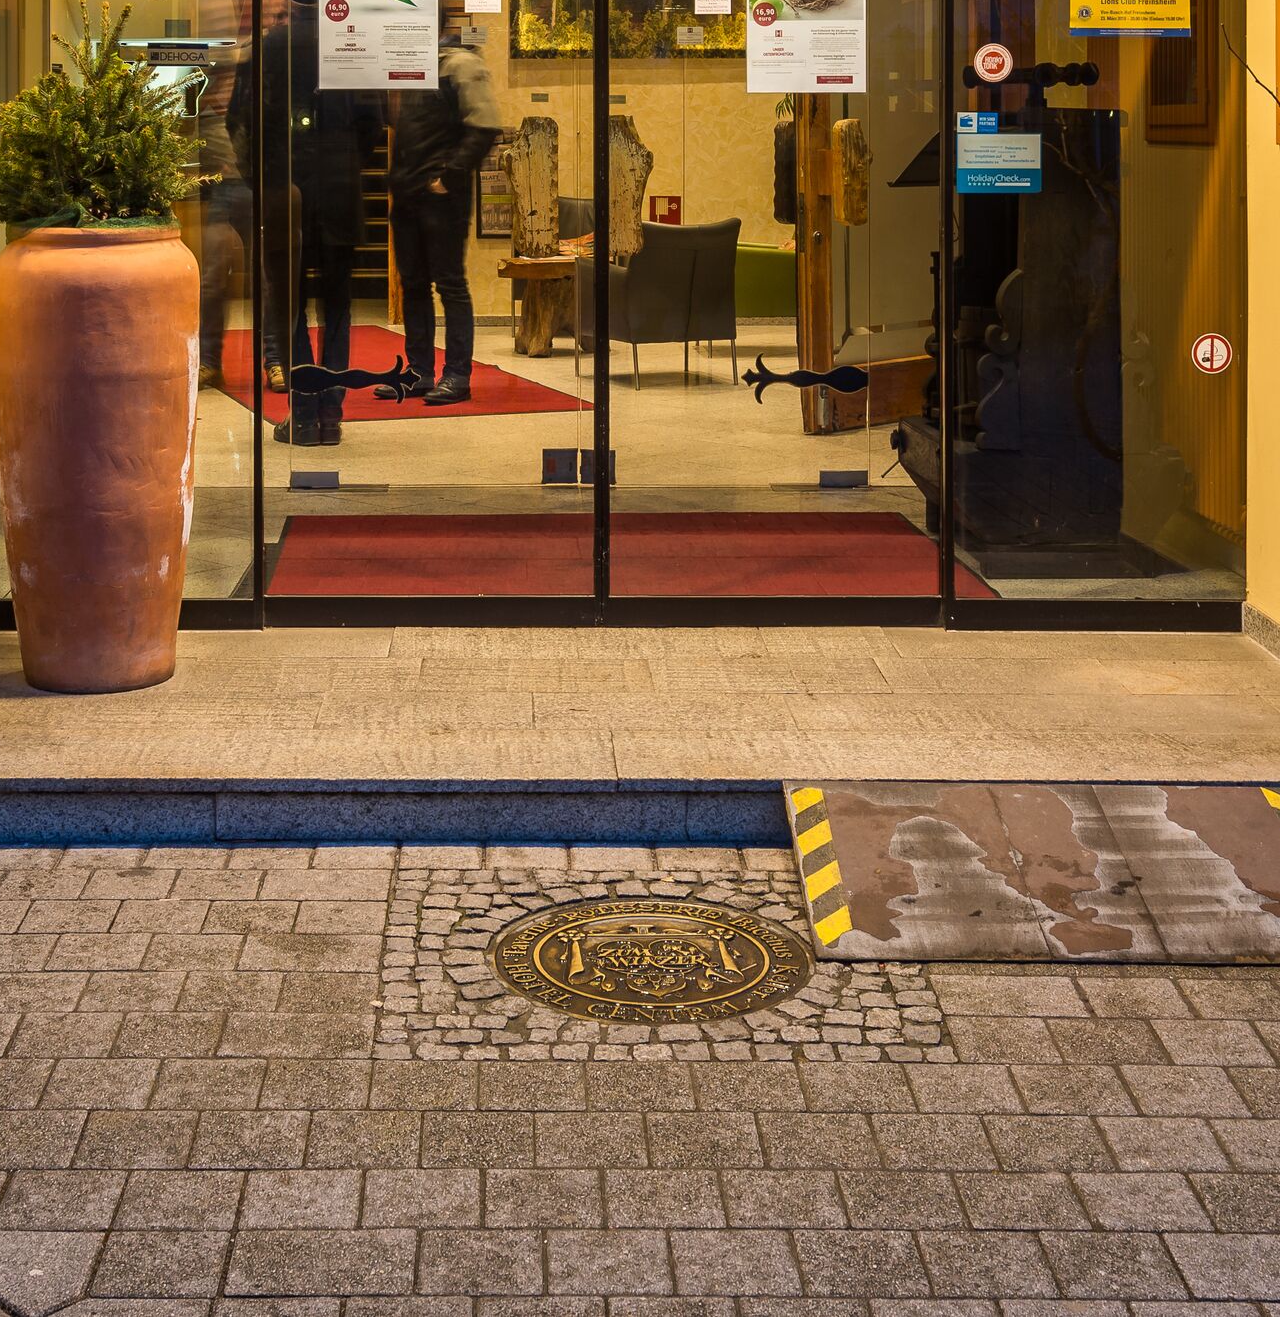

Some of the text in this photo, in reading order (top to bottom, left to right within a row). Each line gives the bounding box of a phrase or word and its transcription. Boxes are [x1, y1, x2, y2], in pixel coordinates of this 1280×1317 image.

[328, 3, 347, 12] 16,90
[756, 8, 775, 16] 16,90
[160, 52, 205, 61] DEHOGA
[967, 174, 1031, 185] HolidayCheck.com
[562, 902, 724, 921] ROTISSERIE
[504, 963, 750, 1023] HOTEL CENTRAL
